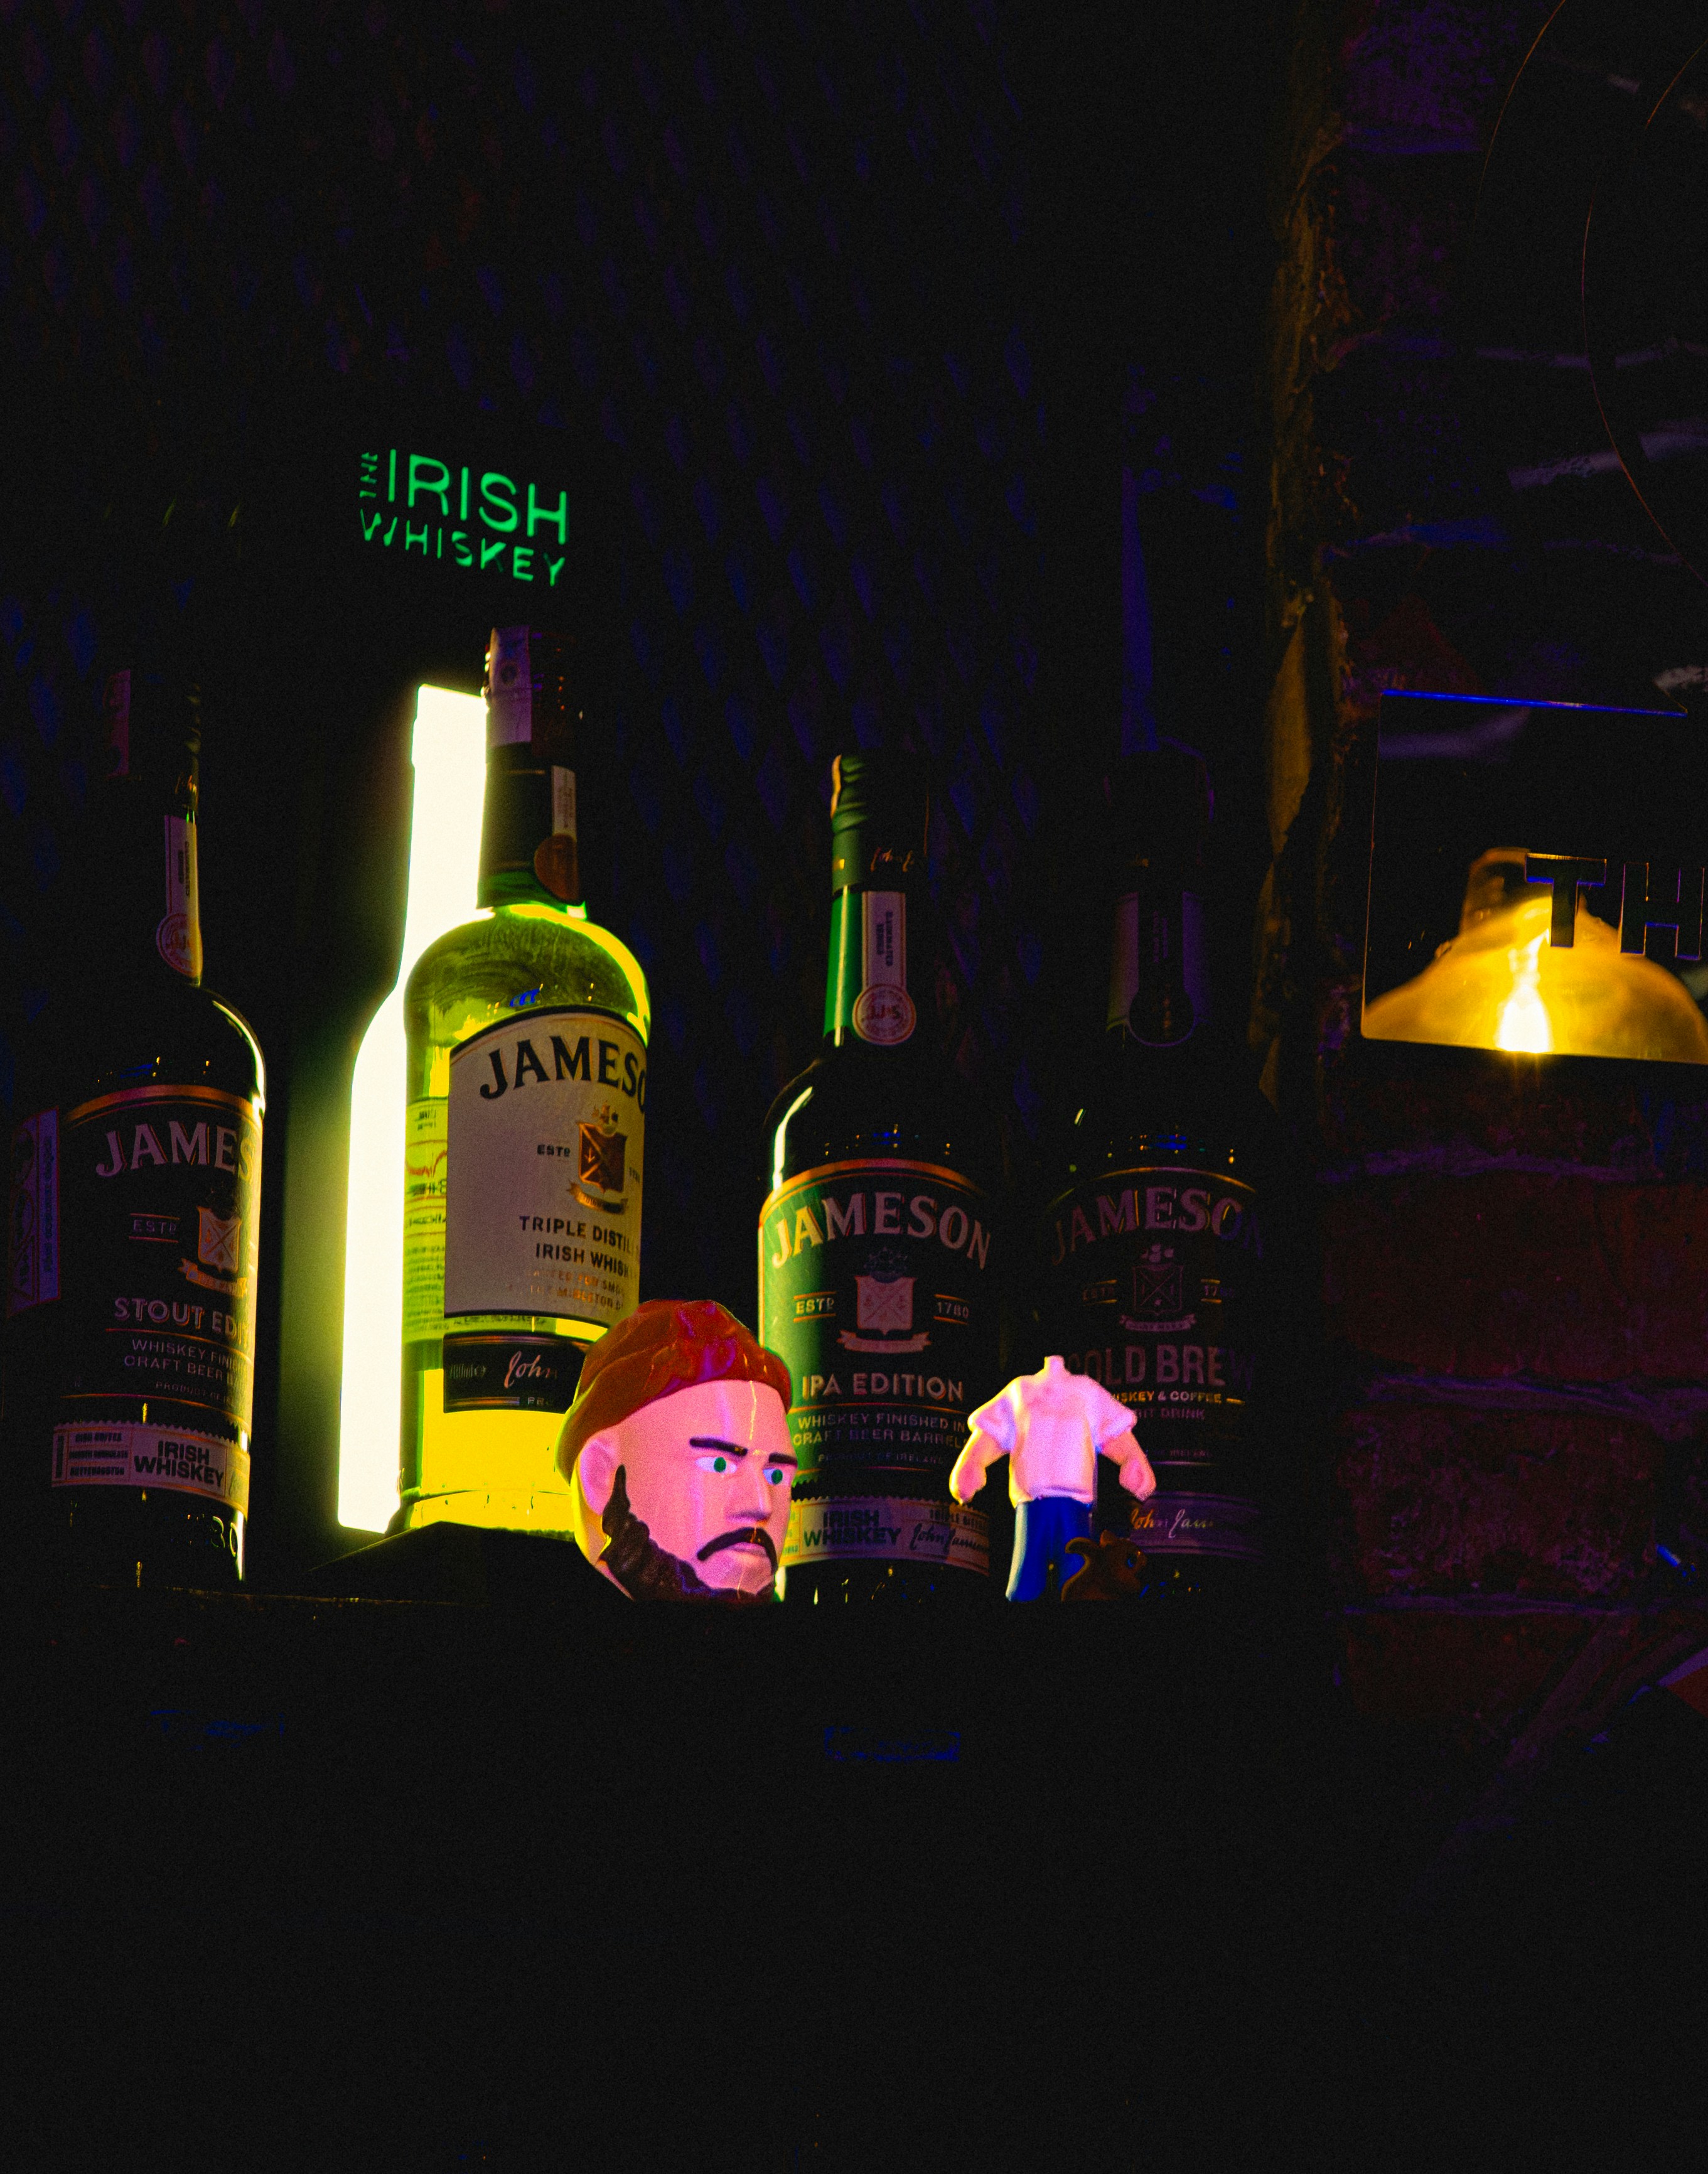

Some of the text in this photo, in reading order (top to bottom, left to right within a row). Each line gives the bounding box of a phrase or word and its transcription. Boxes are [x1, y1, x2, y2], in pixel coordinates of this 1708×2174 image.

[388, 448, 569, 545] IRISH
[359, 508, 566, 586] WHISKEY
[519, 1215, 586, 1238] TRIPLE
[771, 1192, 991, 1270] JAMESON
[535, 1242, 584, 1264] IRISH
[114, 1296, 205, 1330] STOUT
[131, 1338, 207, 1361] WHISKEY
[802, 1372, 964, 1402] IPA EDITION
[1169, 1390, 1222, 1404] COFFEE
[798, 1413, 965, 1433] WHISKEY FINISHED IN
[157, 1440, 210, 1466] IRISH
[134, 1455, 225, 1487] WHISKEY
[823, 1509, 879, 1526] IRISH
[803, 1526, 901, 1547] WHISKEY
